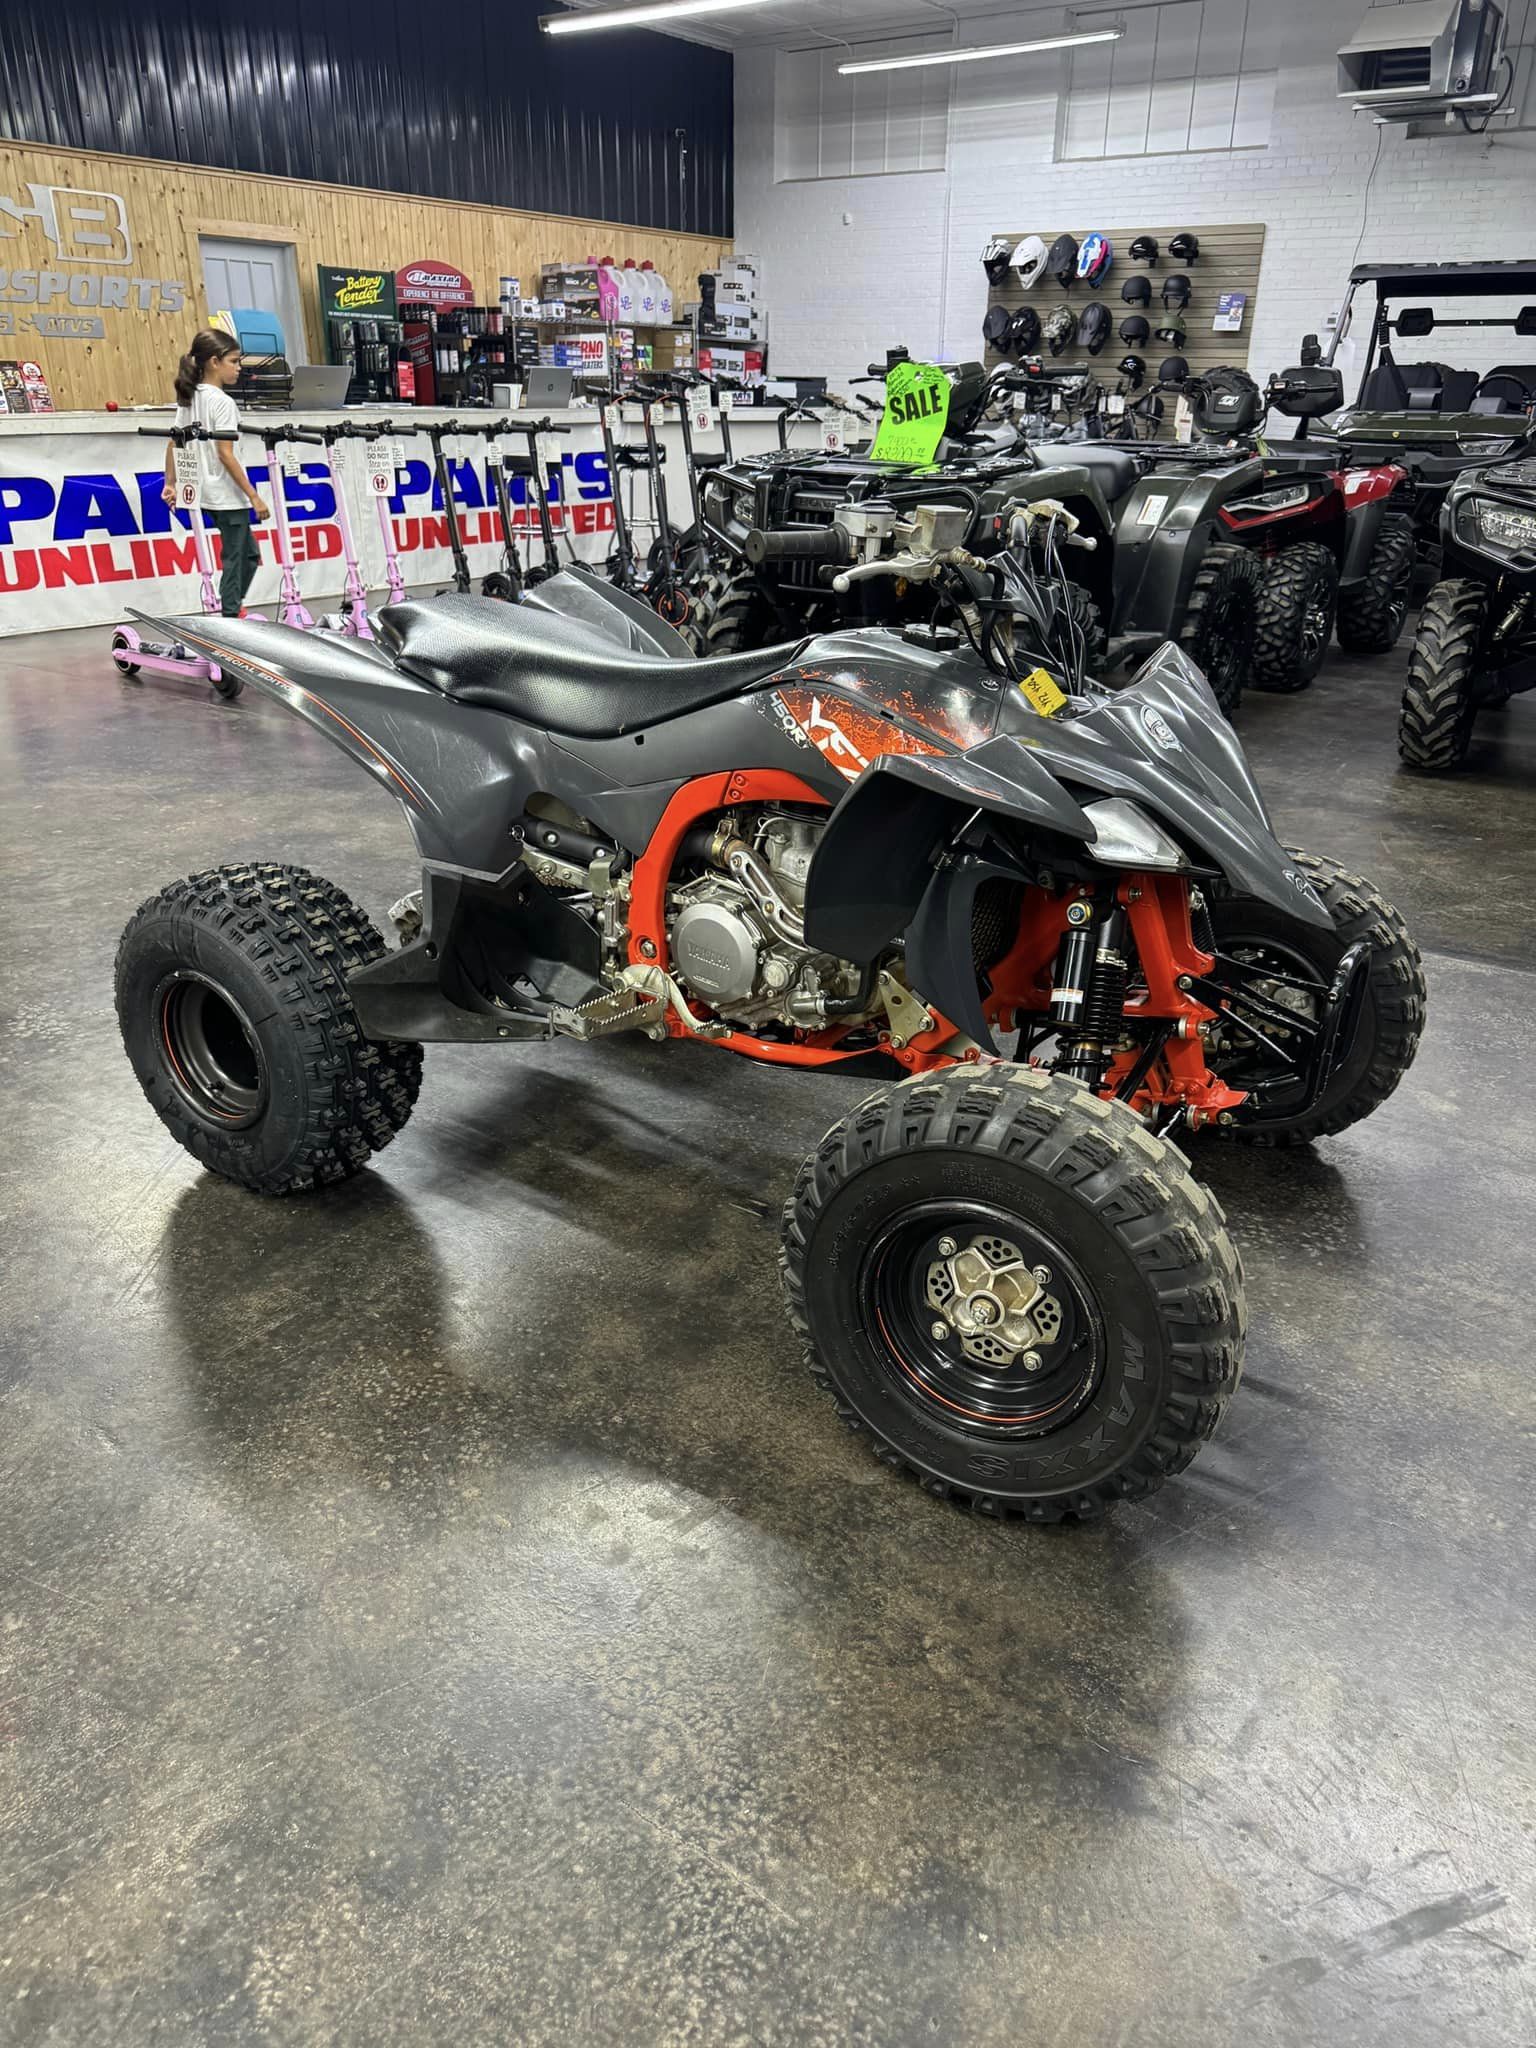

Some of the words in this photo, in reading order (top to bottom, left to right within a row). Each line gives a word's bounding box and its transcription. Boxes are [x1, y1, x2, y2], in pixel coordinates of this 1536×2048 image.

[346, 275, 382, 290] Battery
[335, 286, 379, 307] Tender
[46, 317, 95, 334] ATVS
[889, 384, 943, 425] SALE
[257, 672, 294, 694] EDITIO
